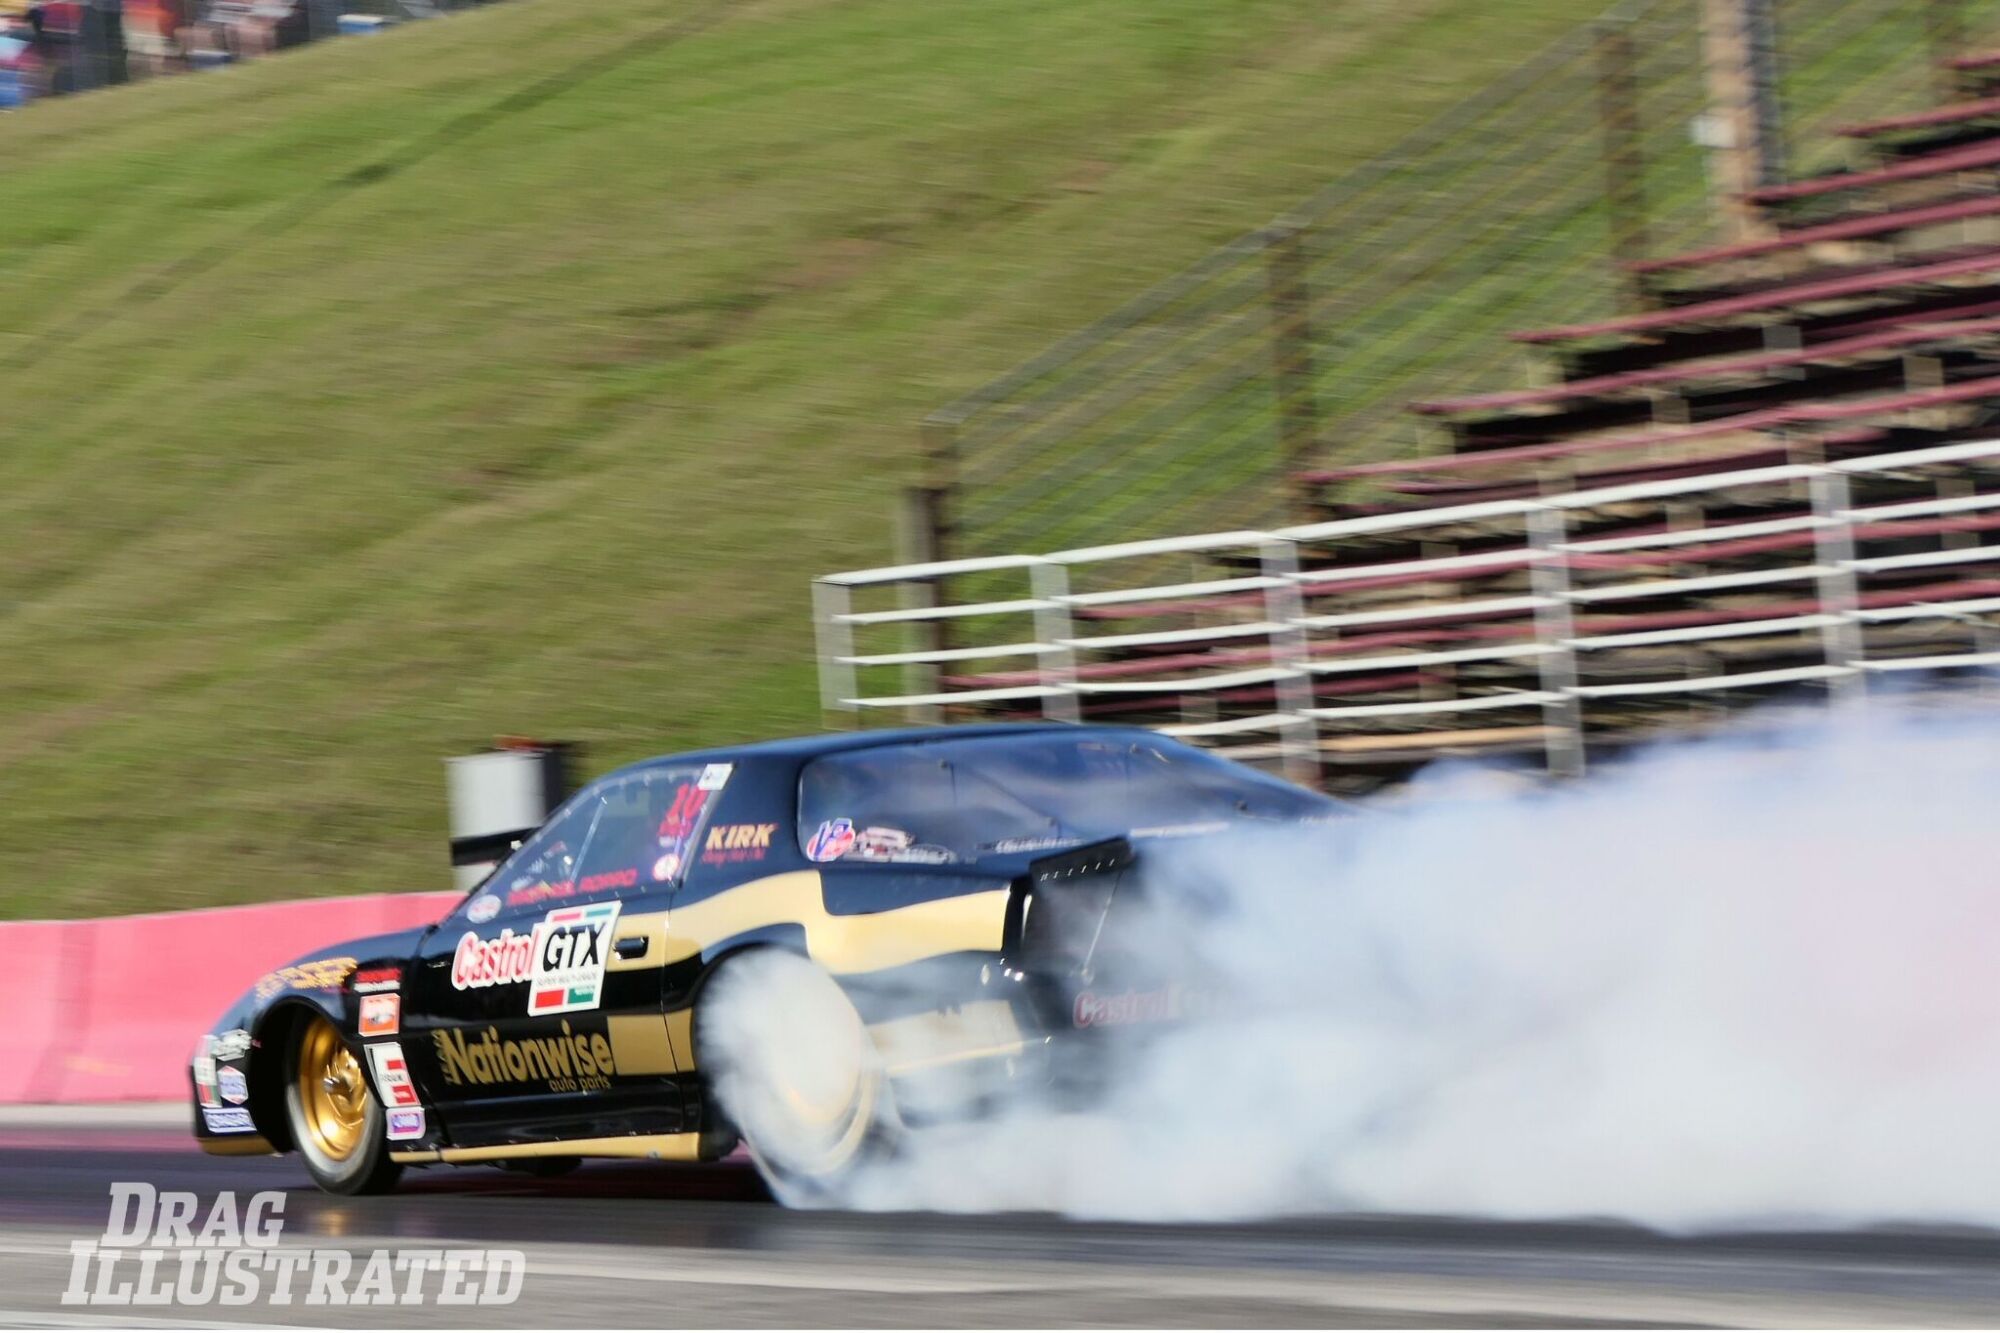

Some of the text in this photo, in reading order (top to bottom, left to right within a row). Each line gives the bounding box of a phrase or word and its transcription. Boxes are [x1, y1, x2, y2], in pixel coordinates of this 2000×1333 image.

[705, 824, 777, 850] KIRK
[453, 922, 608, 990] Castrol GTX
[433, 1019, 614, 1086] Nationwise
[549, 1075, 612, 1093] auto parts
